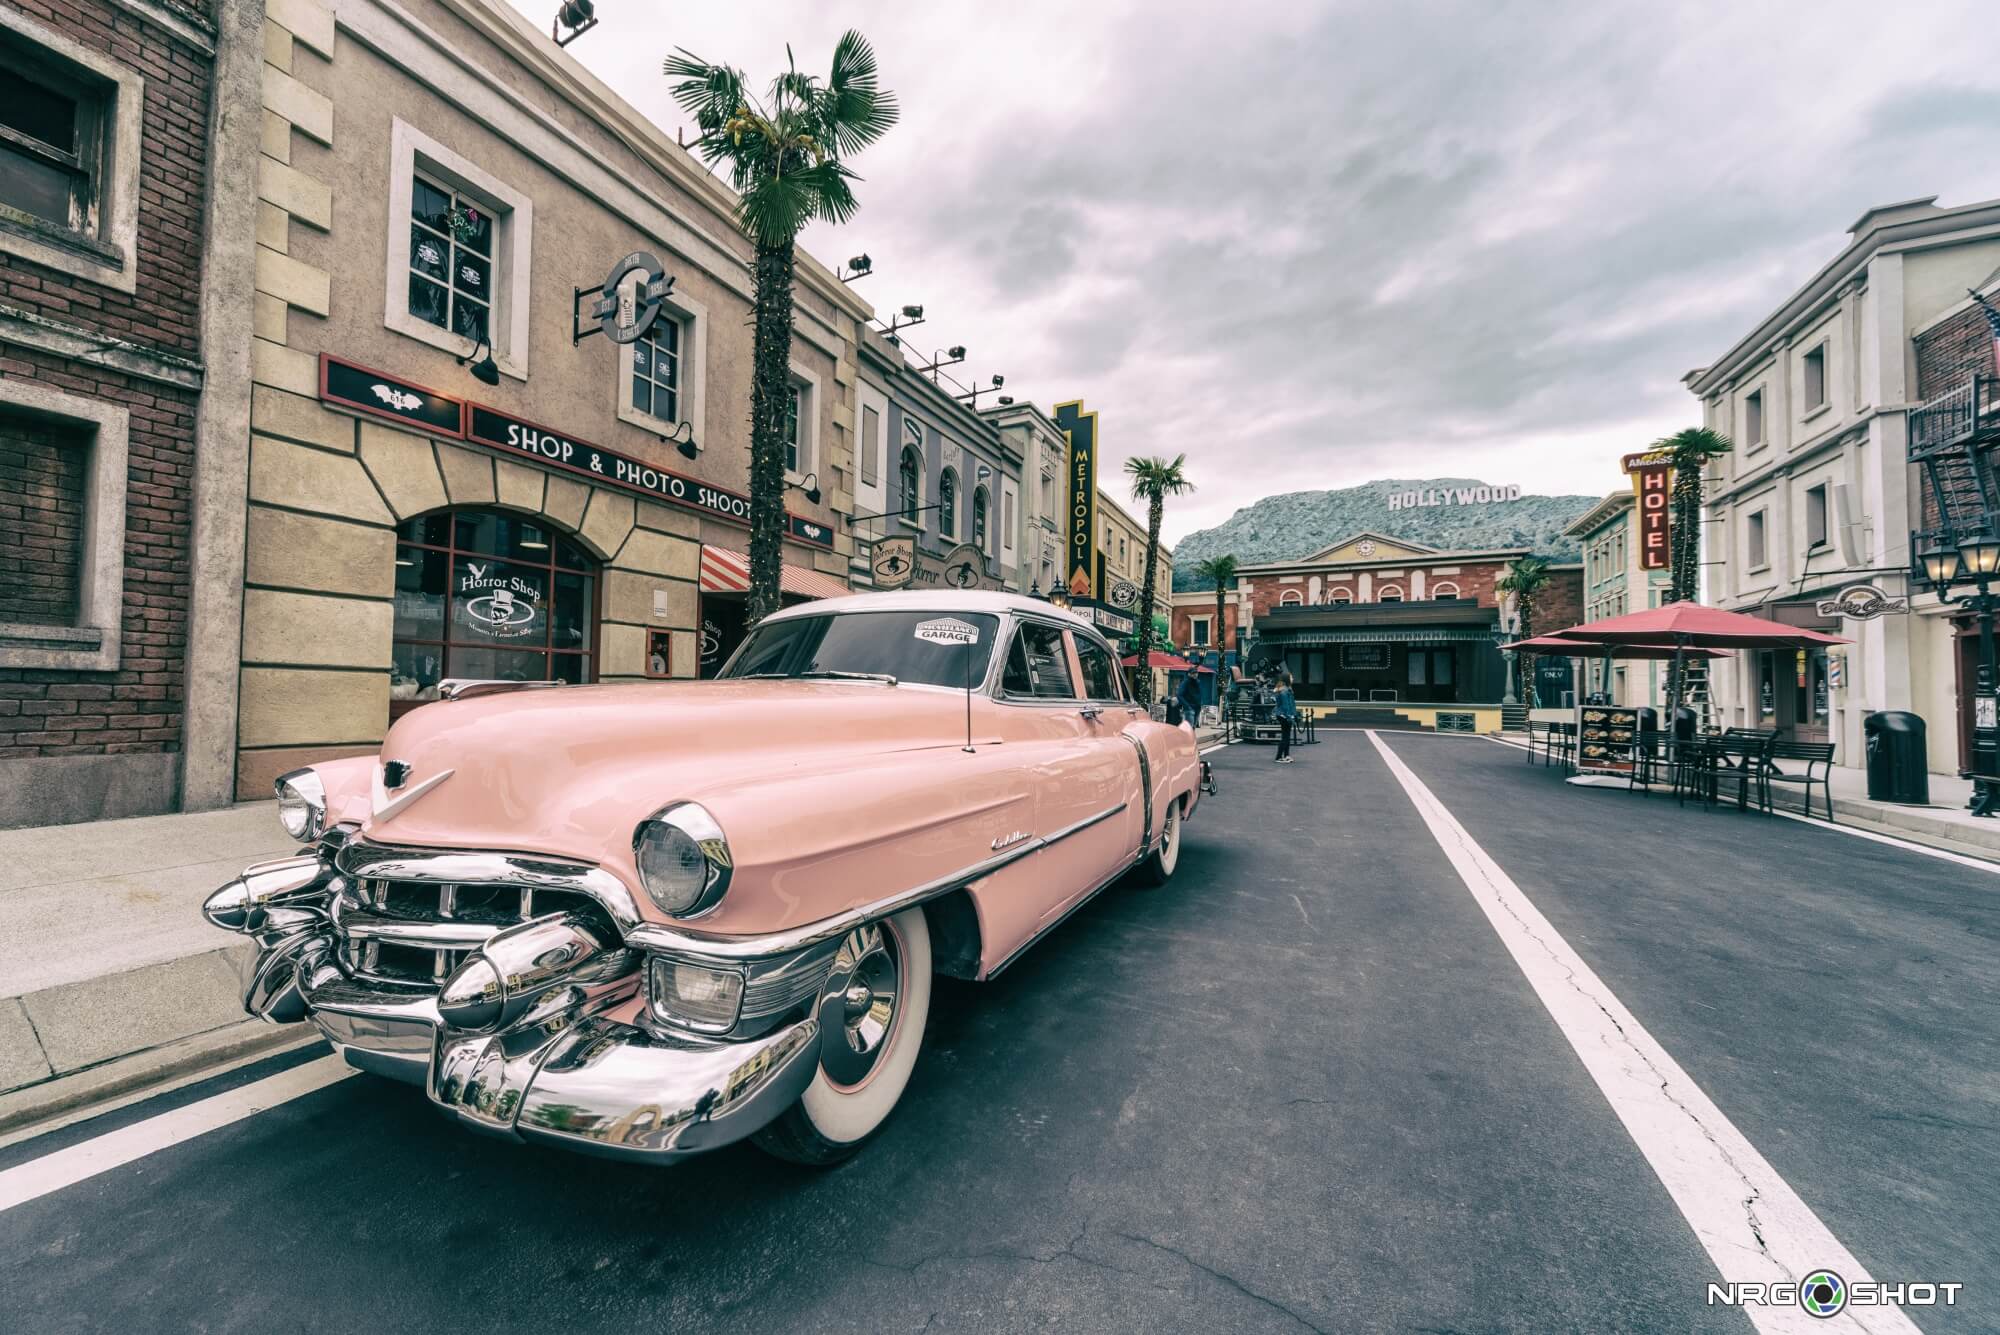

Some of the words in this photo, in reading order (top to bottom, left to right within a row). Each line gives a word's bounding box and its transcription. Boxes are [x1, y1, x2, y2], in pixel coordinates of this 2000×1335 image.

[390, 392, 405, 405] 616
[508, 424, 573, 462] SHOP
[590, 453, 603, 474] &
[617, 459, 685, 497] PHOTO
[1075, 450, 1088, 559] METROPOL
[1388, 484, 1521, 511] HOLLYWOOD
[1645, 473, 1664, 567] HOTEL
[873, 547, 896, 562] Horror
[898, 544, 913, 562] Shop
[462, 576, 507, 591] Horror
[511, 577, 540, 602] Shop
[704, 620, 721, 638] Shop
[922, 631, 971, 642] GARAGE
